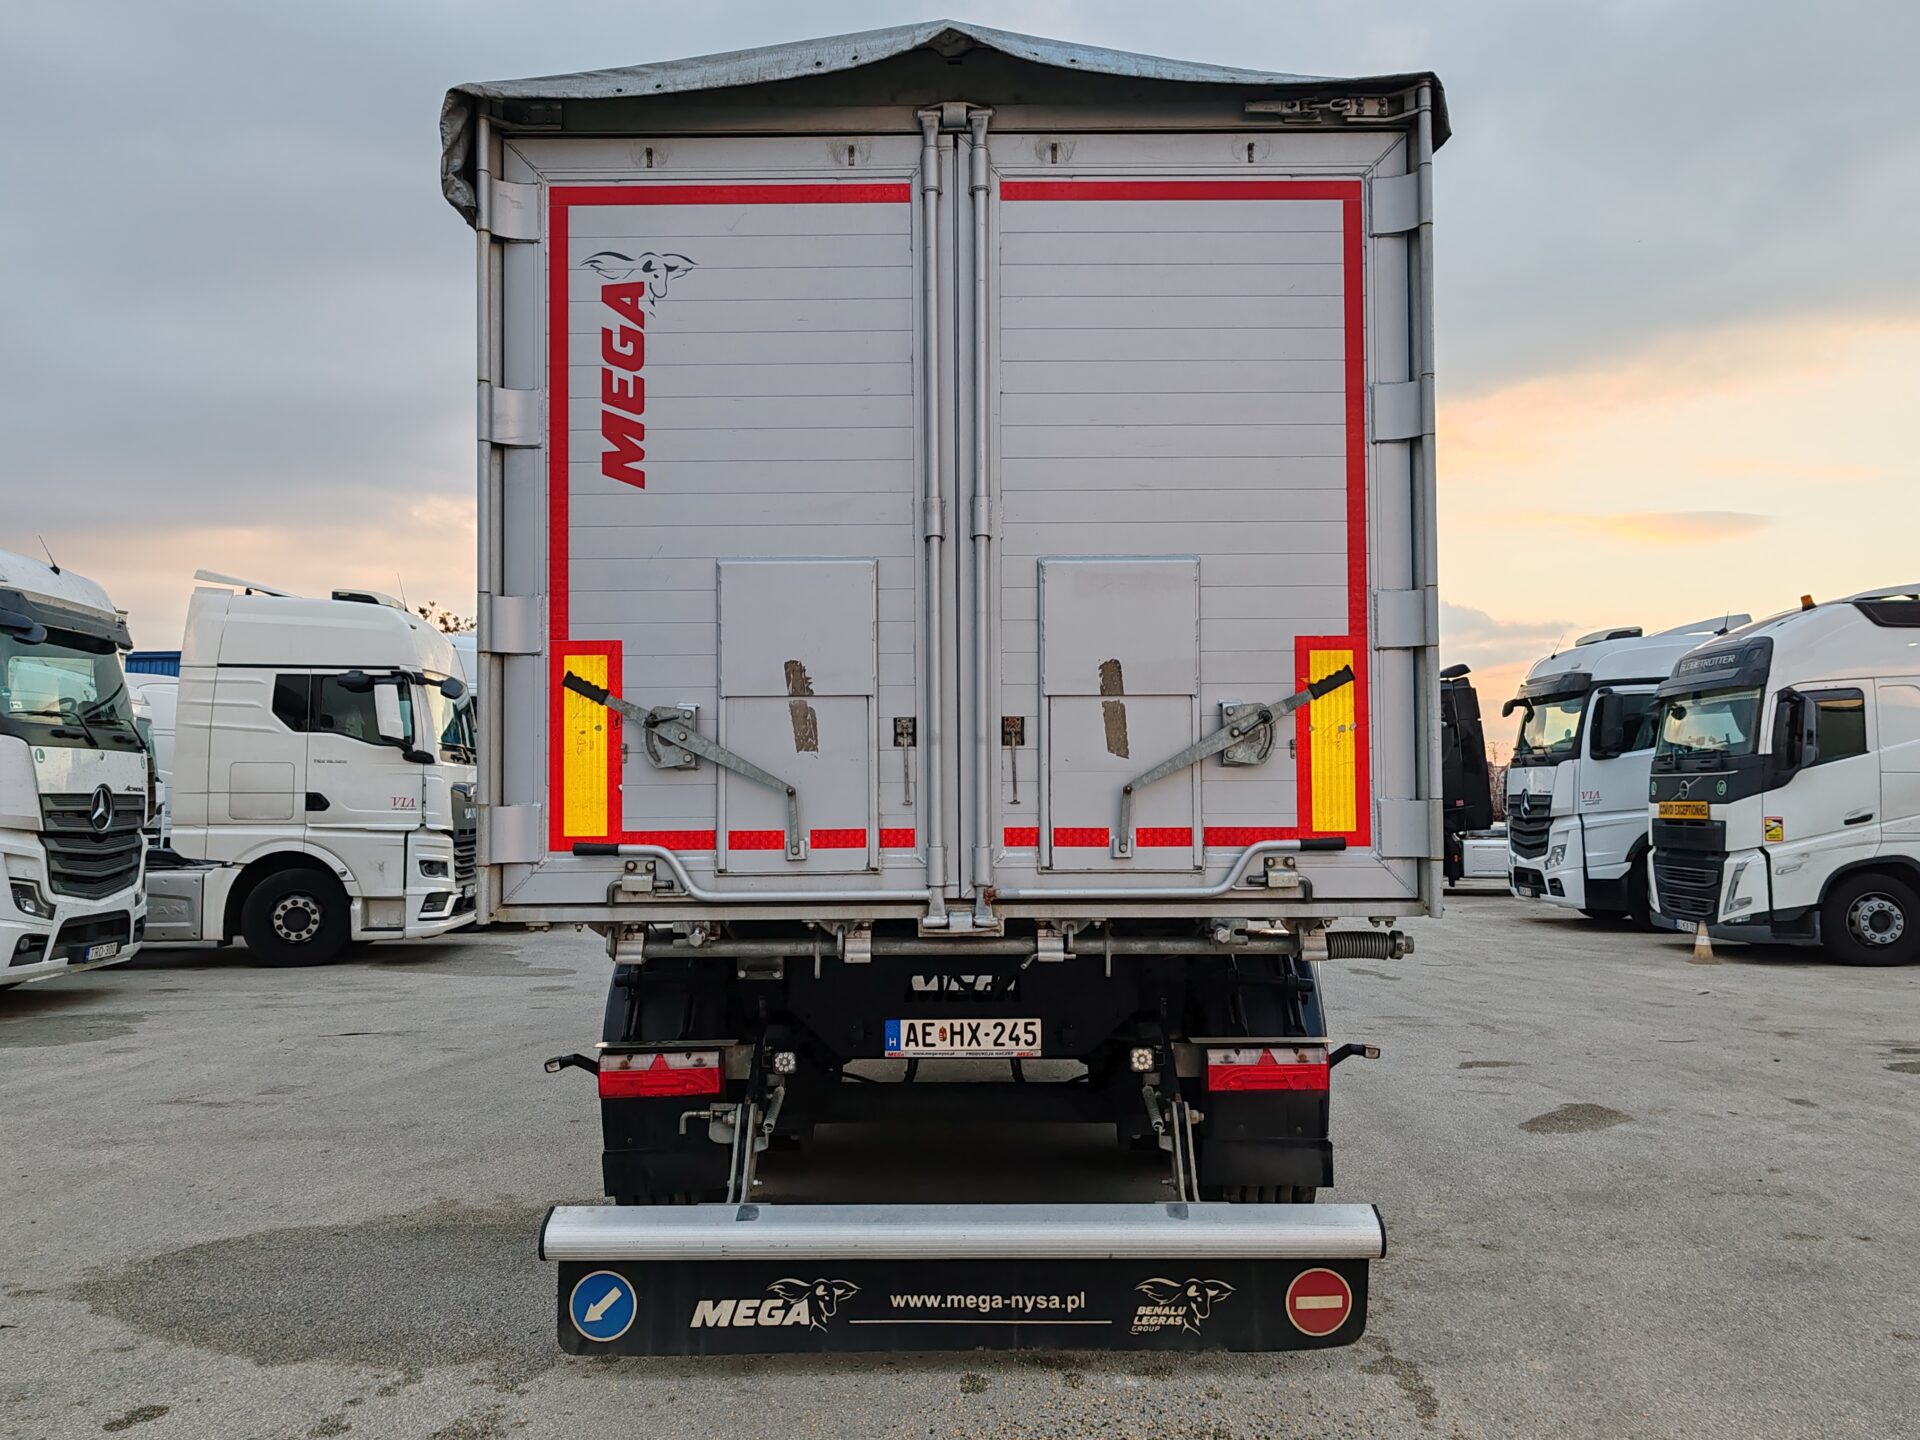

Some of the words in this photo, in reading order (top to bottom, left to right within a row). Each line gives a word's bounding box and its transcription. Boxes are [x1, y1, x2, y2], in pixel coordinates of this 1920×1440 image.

[601, 281, 645, 490] MEGA
[1581, 790, 1600, 800] VIA
[391, 796, 416, 807] VIA
[888, 1037, 897, 1047] H
[890, 1291, 1086, 1313] www.mega-nysa.pl
[690, 1299, 811, 1328] MEGA
[1136, 1306, 1188, 1315] BENALU
[1133, 1316, 1183, 1325] LEGRAS
